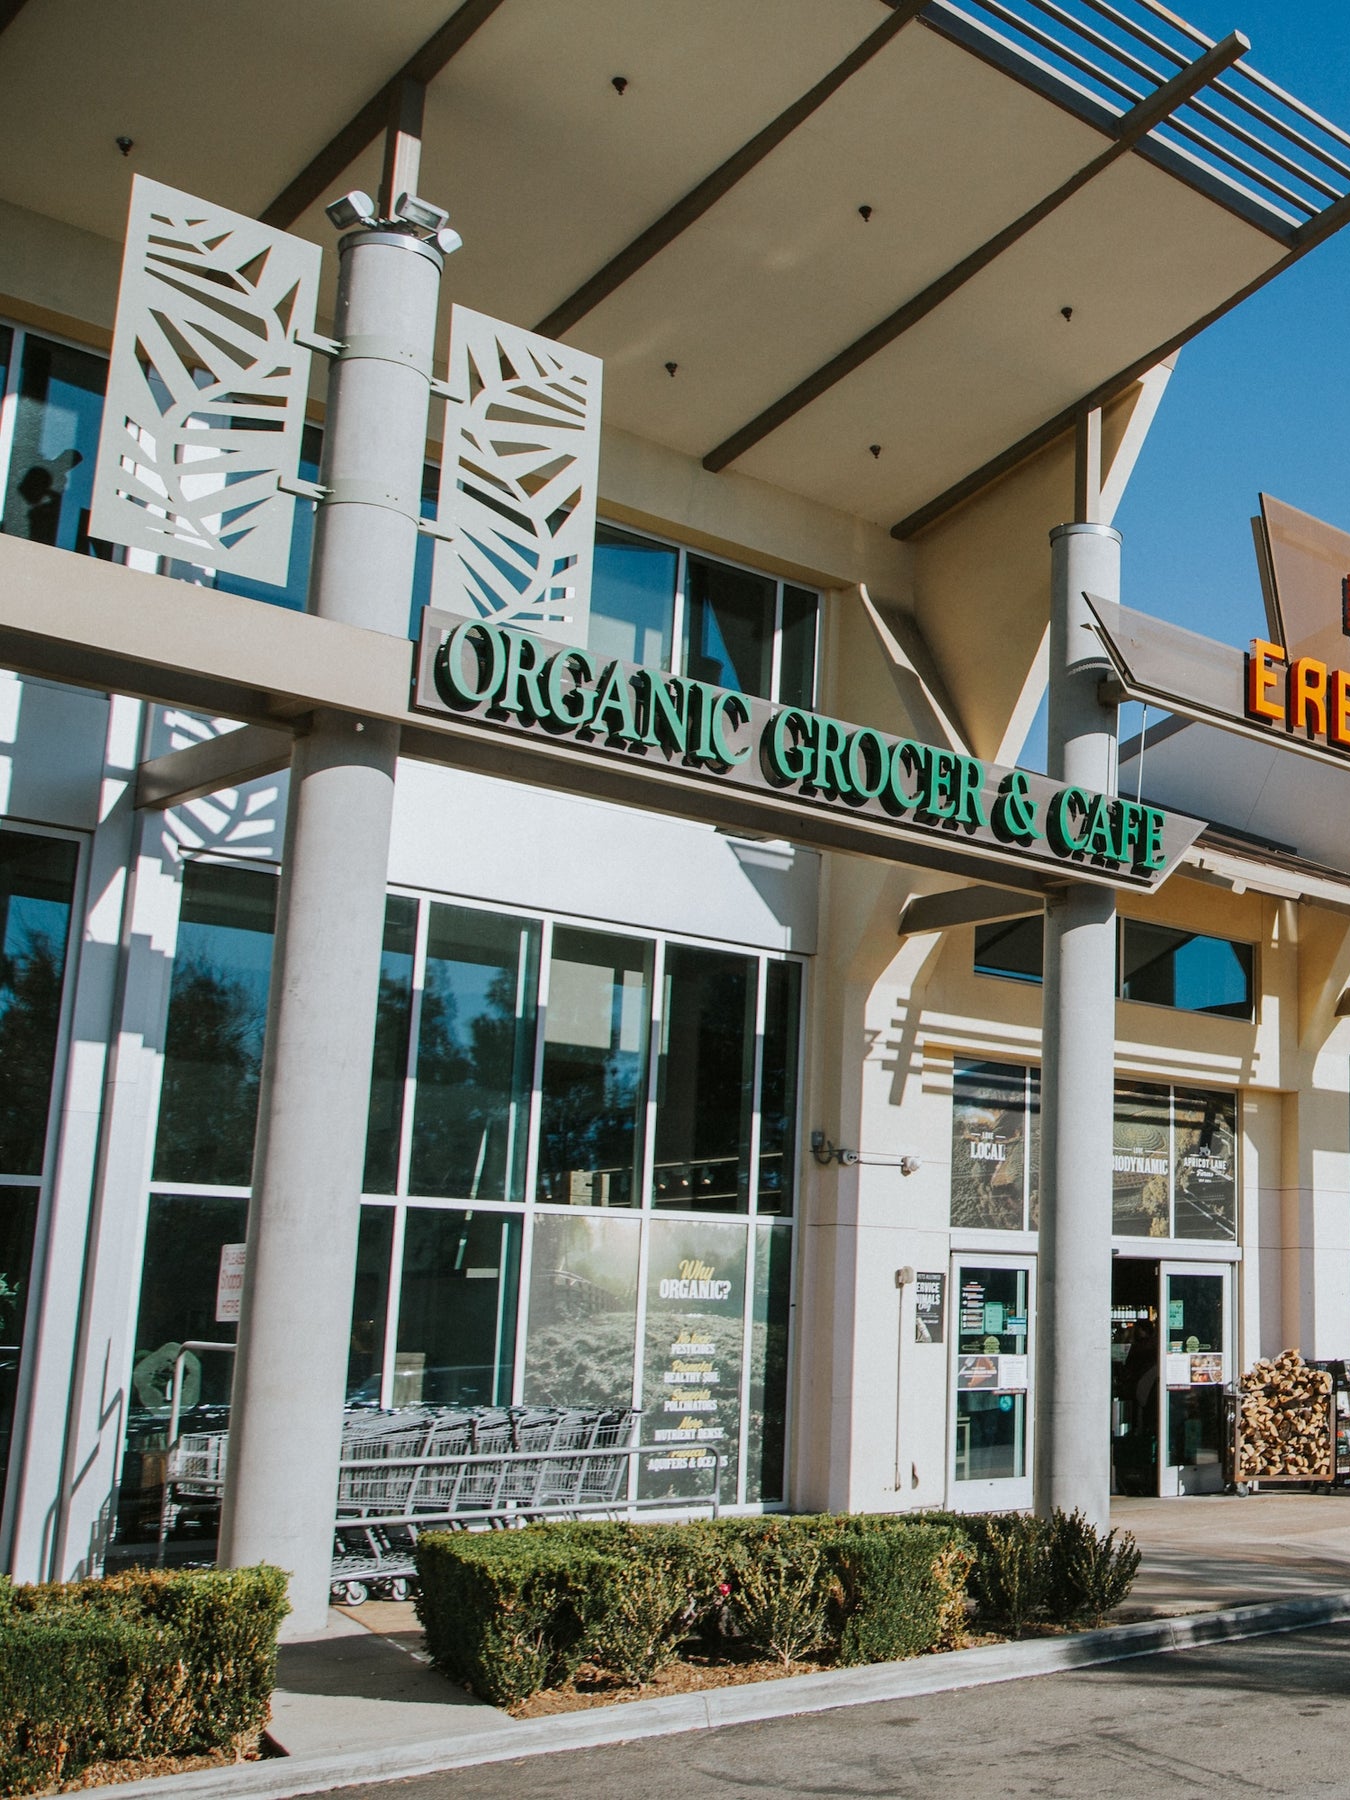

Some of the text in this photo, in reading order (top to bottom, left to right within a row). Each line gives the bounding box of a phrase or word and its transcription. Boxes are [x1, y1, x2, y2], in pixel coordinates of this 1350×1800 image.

[446, 618, 1168, 871] ORGANIC GROCER & CAFE
[970, 1141, 1006, 1161] LOCAL
[678, 1259, 716, 1284] Why
[658, 1278, 732, 1300] ORGANIC?
[916, 1281, 941, 1293] ERVICE
